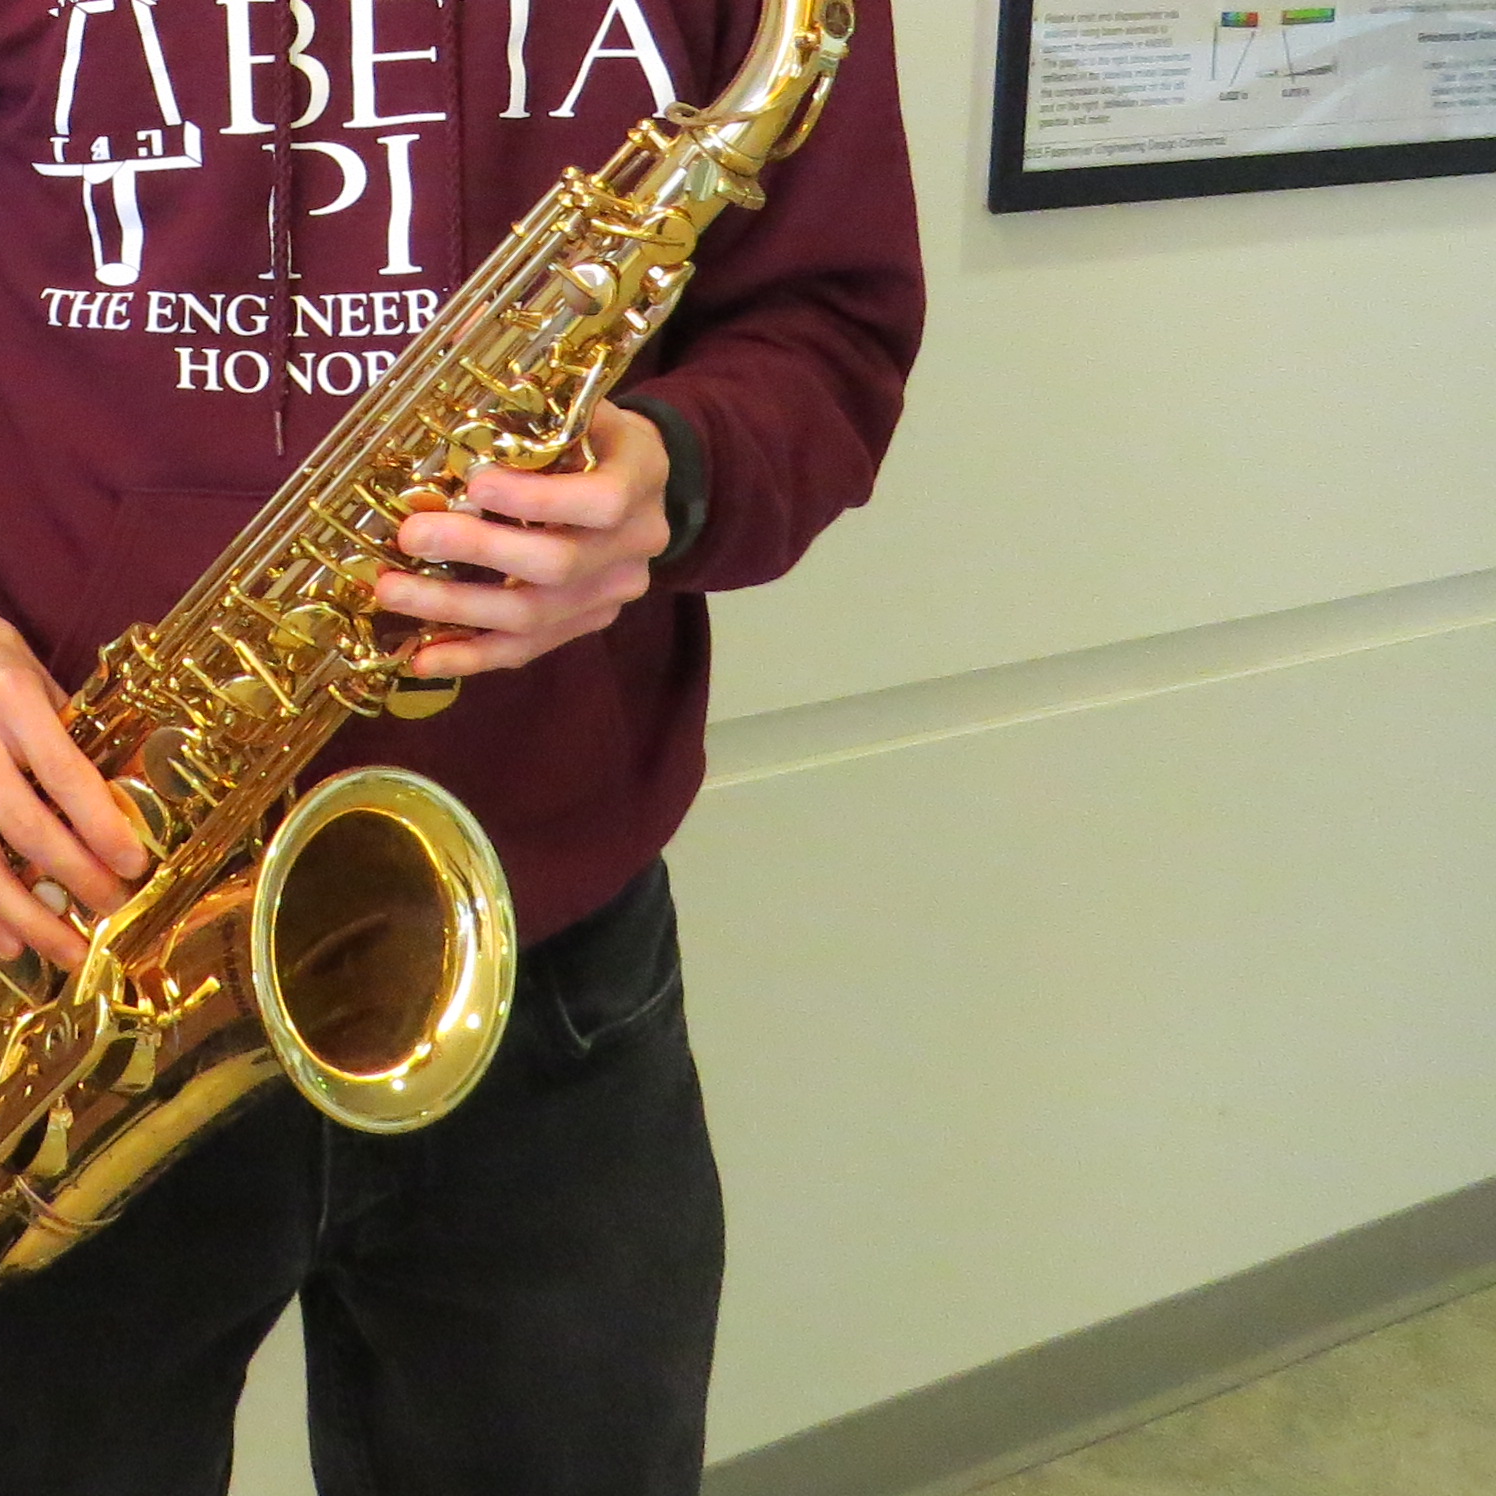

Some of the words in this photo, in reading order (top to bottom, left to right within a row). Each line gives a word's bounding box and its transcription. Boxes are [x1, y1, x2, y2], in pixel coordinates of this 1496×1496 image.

[258, 133, 423, 280] PI
[40, 287, 134, 331] THE
[144, 287, 448, 338] ENGNEER
